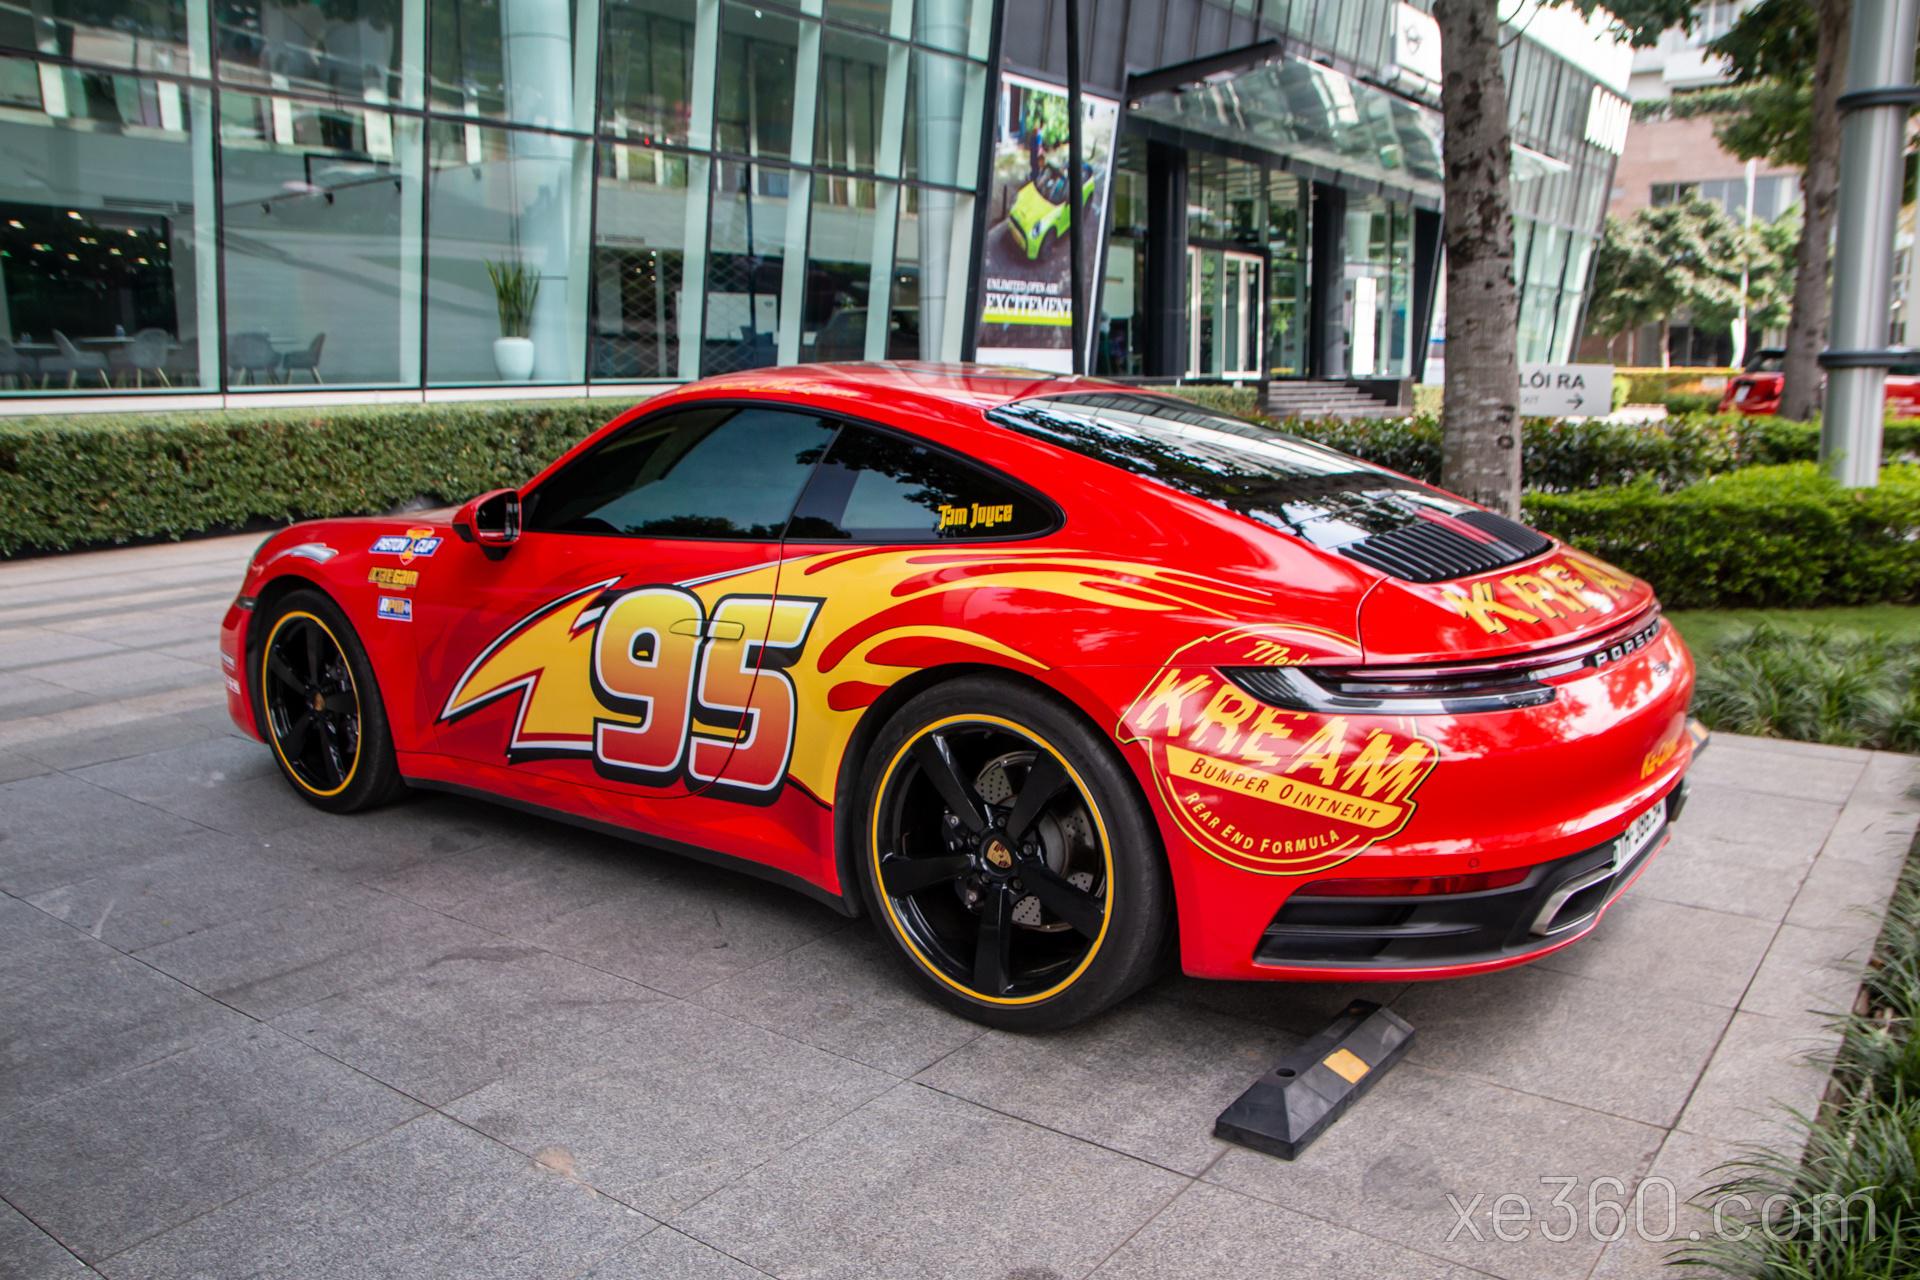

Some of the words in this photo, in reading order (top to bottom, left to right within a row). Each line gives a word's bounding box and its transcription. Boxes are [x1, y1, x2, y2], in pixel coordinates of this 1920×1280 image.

[986, 278, 1027, 293] UNLIMITED
[985, 293, 1072, 318] EXCITEMENT
[1556, 373, 1585, 390] RA
[591, 584, 827, 806] 95
[1135, 669, 1433, 803] KREAM
[1189, 756, 1270, 793] BUMPER
[1185, 792, 1221, 829] REAR
[1221, 824, 1254, 850] END
[1260, 829, 1340, 855] FORMULA
